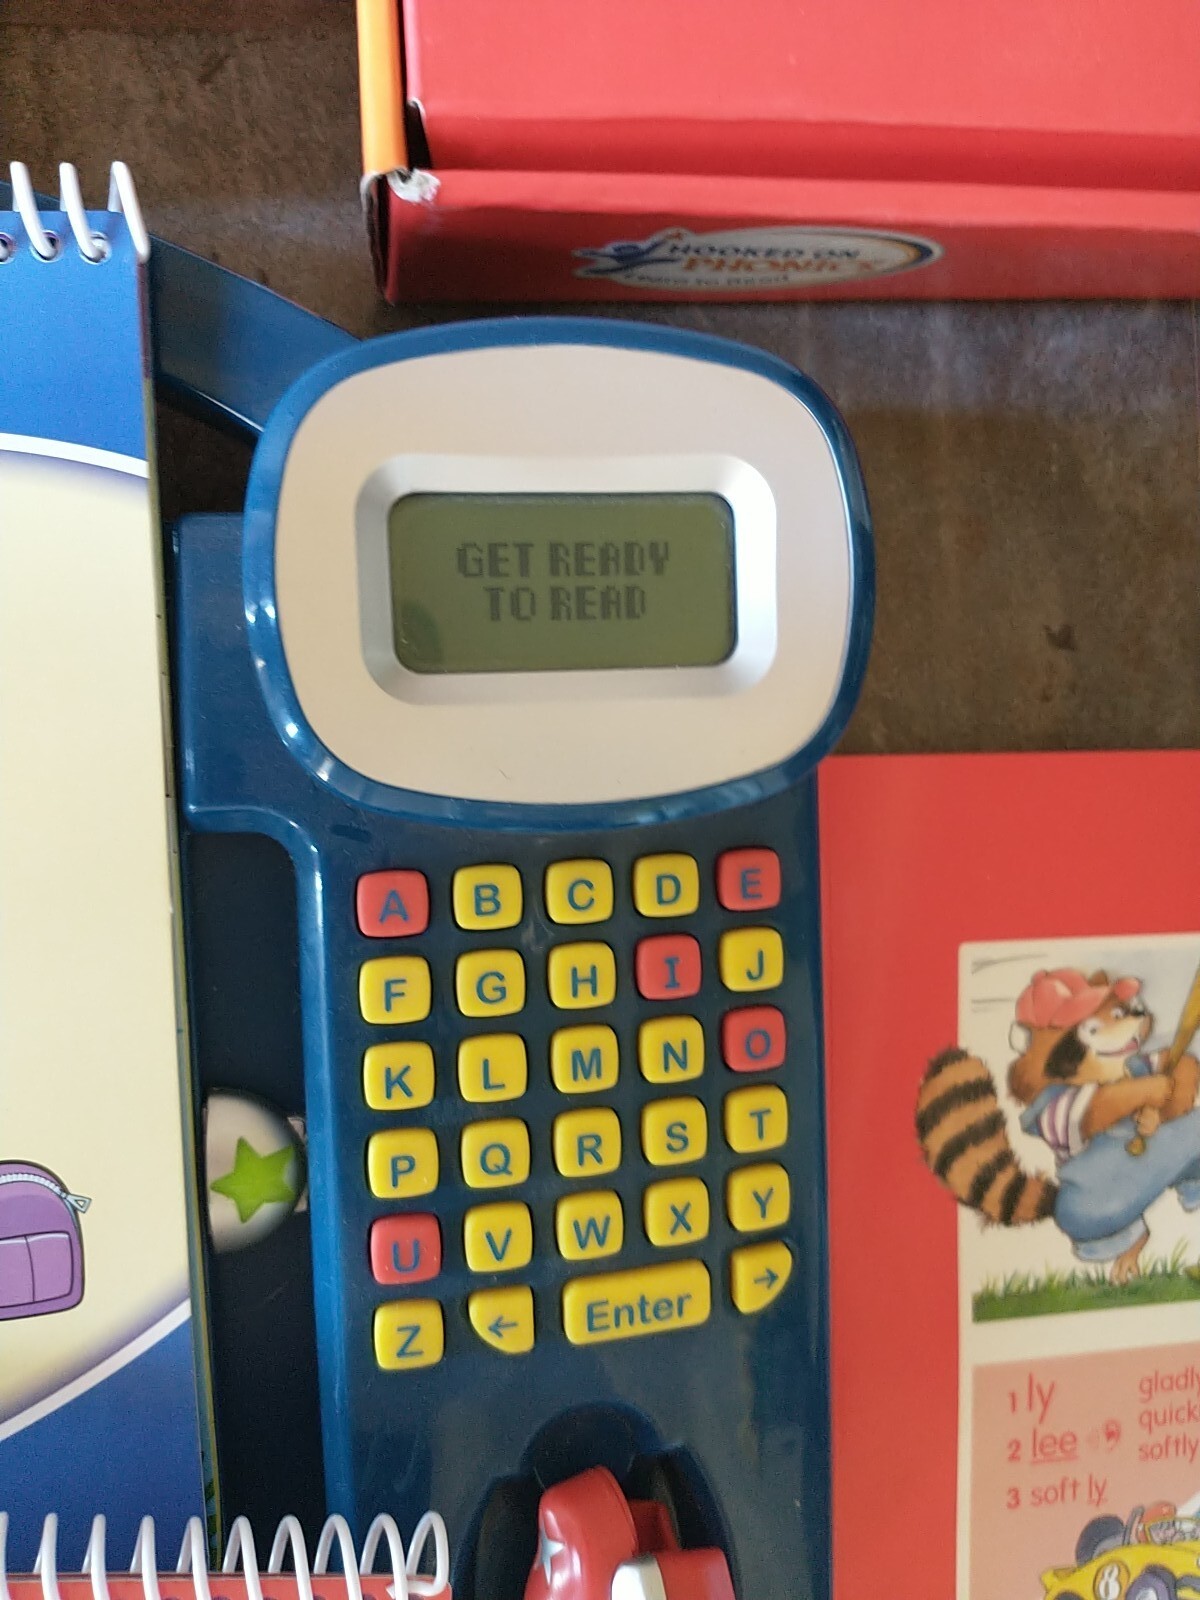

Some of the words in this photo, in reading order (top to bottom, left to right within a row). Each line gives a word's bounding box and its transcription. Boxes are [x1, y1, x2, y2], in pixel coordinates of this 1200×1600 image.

[668, 242, 804, 258] HOOKED
[456, 542, 534, 577] GET
[549, 541, 670, 576] READY
[483, 586, 536, 621] TO
[549, 585, 646, 620] READ
[474, 883, 501, 917] B
[567, 878, 595, 911] C
[656, 873, 681, 906] D
[740, 867, 763, 900] E
[379, 889, 410, 924] A
[571, 965, 598, 998] H
[664, 956, 681, 989] I
[746, 950, 765, 982] J
[384, 978, 407, 1012] F
[476, 971, 507, 1004] G
[663, 1040, 688, 1073] N
[744, 1028, 771, 1060] O
[483, 1058, 505, 1090] L
[571, 1047, 602, 1081] M
[385, 1065, 413, 1100] K
[666, 1121, 690, 1153] S
[749, 1108, 772, 1141] T
[480, 1143, 512, 1176] Q
[577, 1133, 603, 1167] R
[391, 1155, 415, 1188] P
[670, 1201, 692, 1236] X
[752, 1187, 775, 1220] Y
[486, 1228, 512, 1261] V
[573, 1215, 610, 1250] W
[392, 1239, 420, 1274] U
[586, 1289, 693, 1333] Enter
[396, 1325, 423, 1358] Z
[1026, 1372, 1055, 1424] ly
[1138, 1400, 1200, 1434] quick
[1007, 1438, 1022, 1462] 2
[1031, 1428, 1078, 1463] lee
[1138, 1432, 1200, 1464] softly
[1007, 1487, 1021, 1509] 3
[1030, 1478, 1080, 1506] soft
[1088, 1474, 1108, 1507] ly
